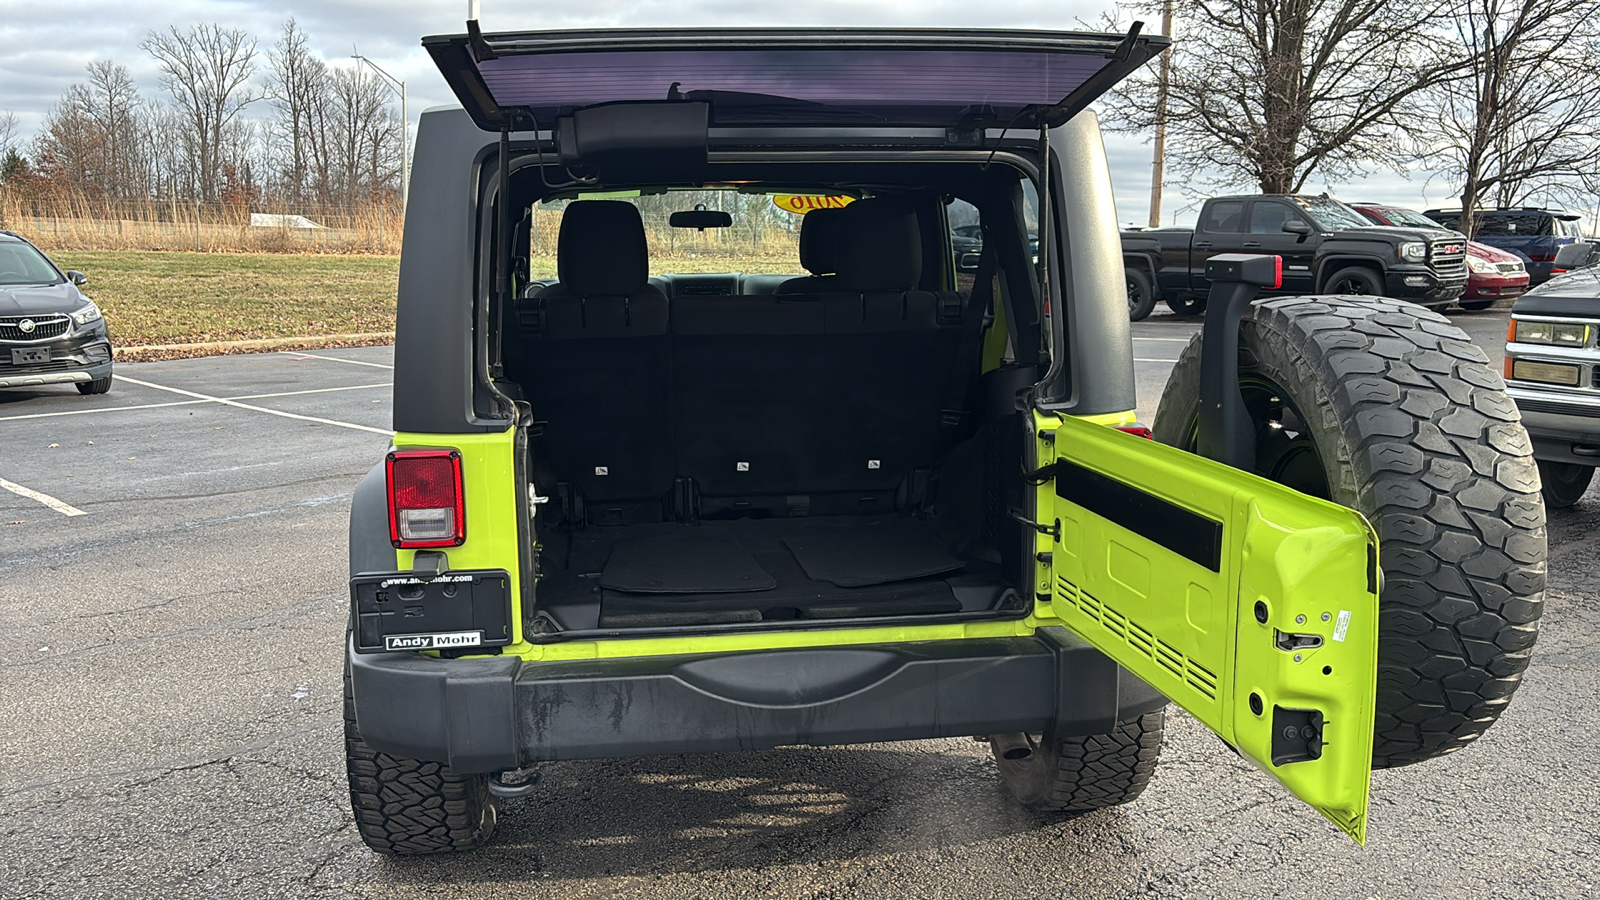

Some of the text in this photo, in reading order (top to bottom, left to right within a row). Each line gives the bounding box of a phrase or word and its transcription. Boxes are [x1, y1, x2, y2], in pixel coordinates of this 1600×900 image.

[386, 574, 473, 586] www.anmohr.com
[391, 635, 478, 647] Andy Mohr
